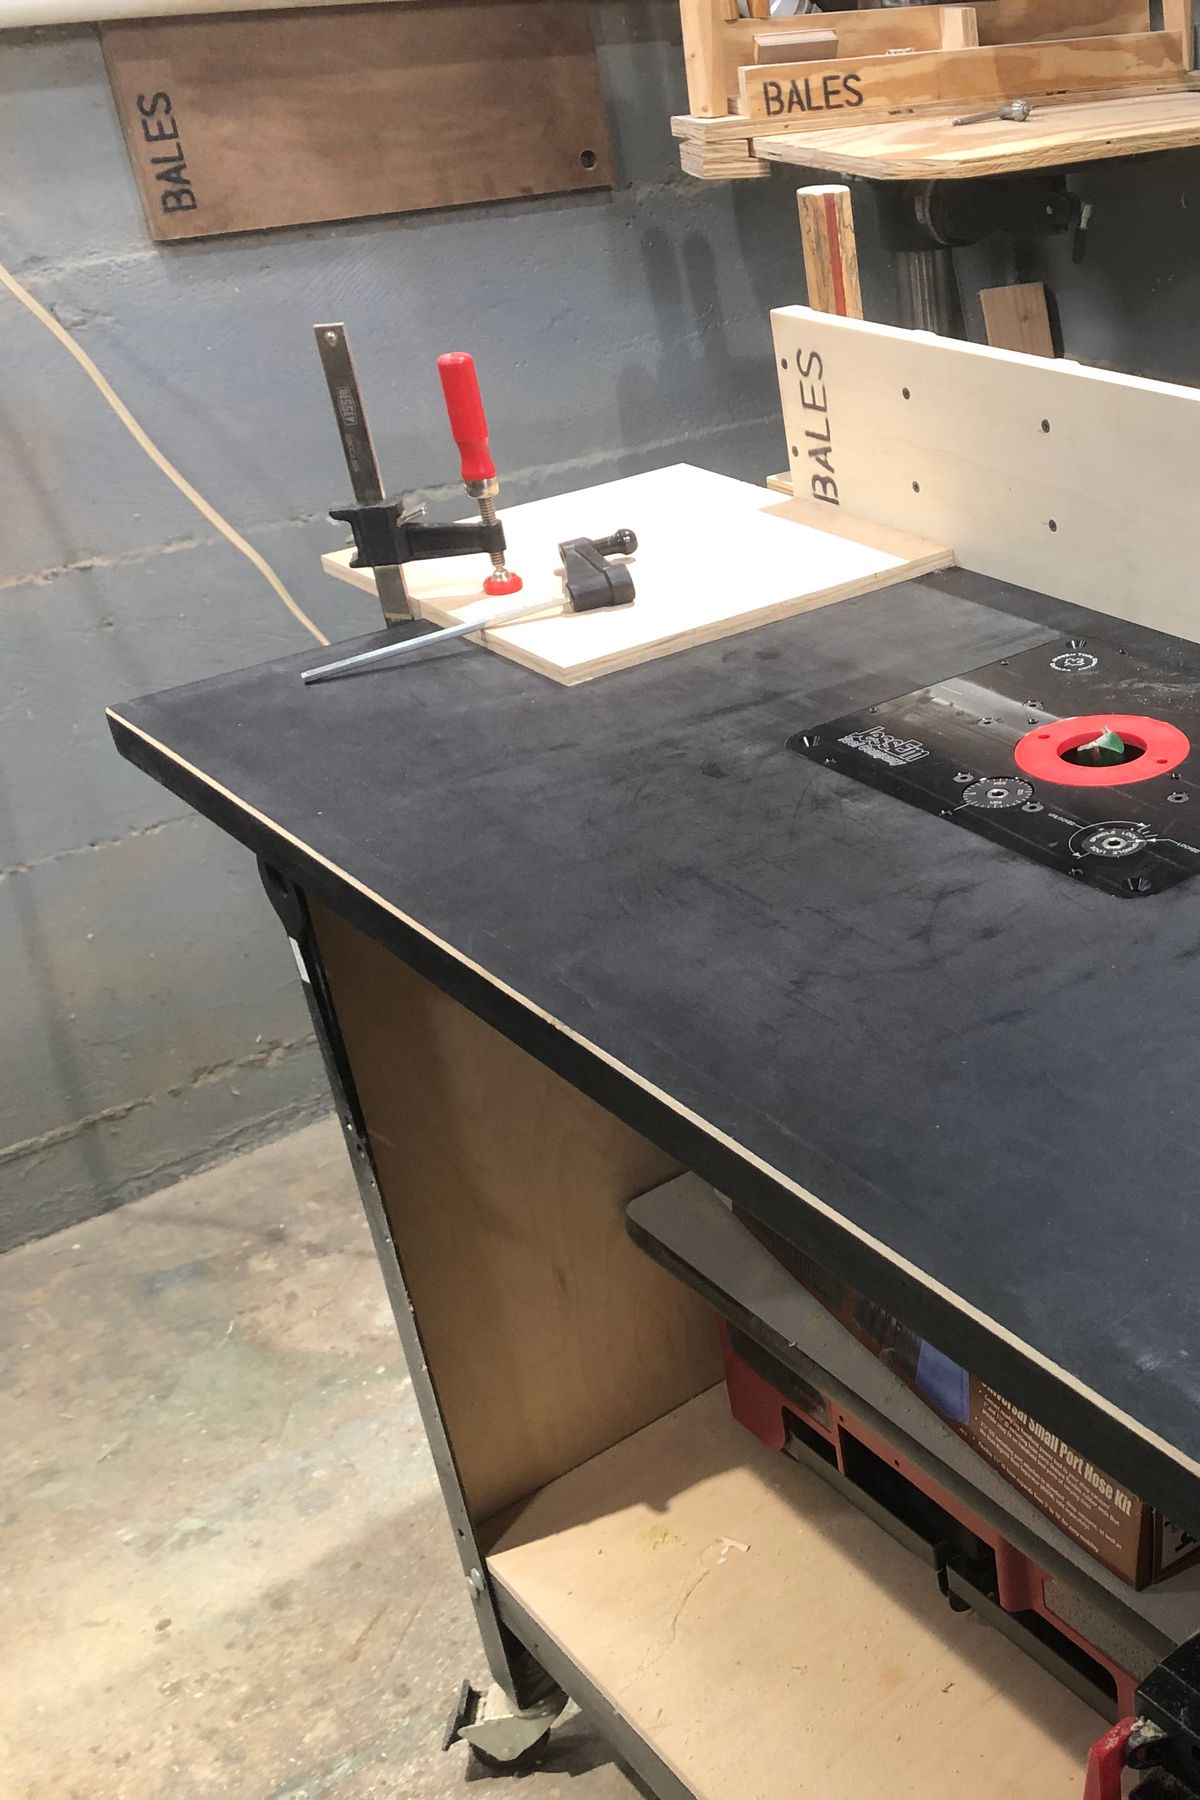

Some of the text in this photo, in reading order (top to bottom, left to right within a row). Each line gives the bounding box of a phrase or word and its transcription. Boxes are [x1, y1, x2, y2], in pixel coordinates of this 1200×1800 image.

[137, 92, 198, 213] BALES
[763, 74, 864, 116] BALES
[796, 348, 840, 506] BALES
[981, 1382, 1027, 1425] ersal
[1028, 1418, 1060, 1452] Small
[1059, 1444, 1085, 1474] Port
[1083, 1463, 1114, 1500] Hose
[1114, 1486, 1134, 1517] Kit
